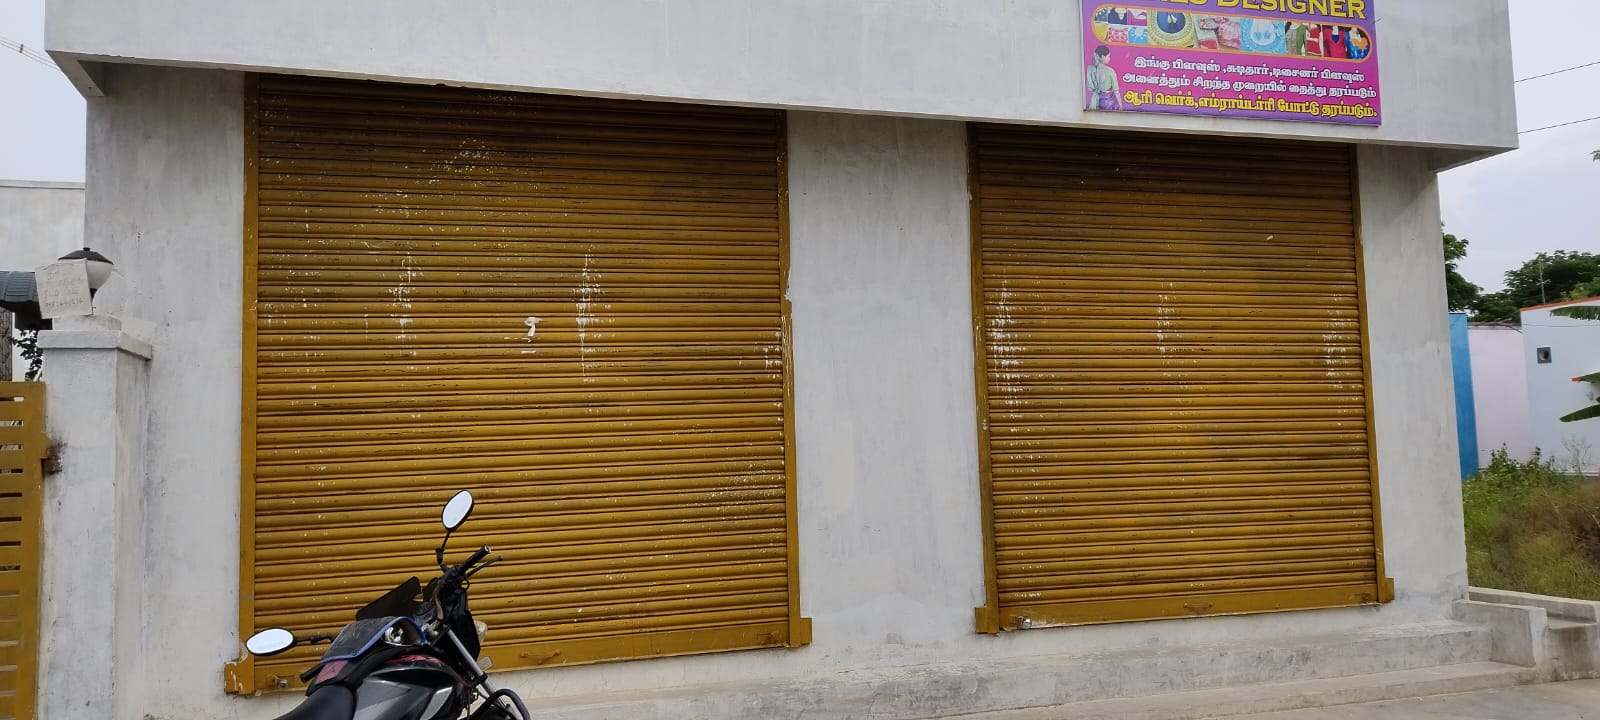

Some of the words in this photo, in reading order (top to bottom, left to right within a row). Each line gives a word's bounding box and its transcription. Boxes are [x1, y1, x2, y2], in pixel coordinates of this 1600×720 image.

[1134, 55, 1170, 70] இங்கு
[1122, 73, 1191, 88] அனைத்தும்
[1193, 76, 1231, 90] சிறந்த
[1233, 80, 1287, 93] முறையில்
[1289, 82, 1327, 97] தைத்து
[1328, 85, 1377, 98] தரப்படும்
[1123, 89, 1153, 106] ஆரி
[1277, 98, 1320, 116] போட்டு
[1321, 100, 1378, 118] தரப்படும்.
